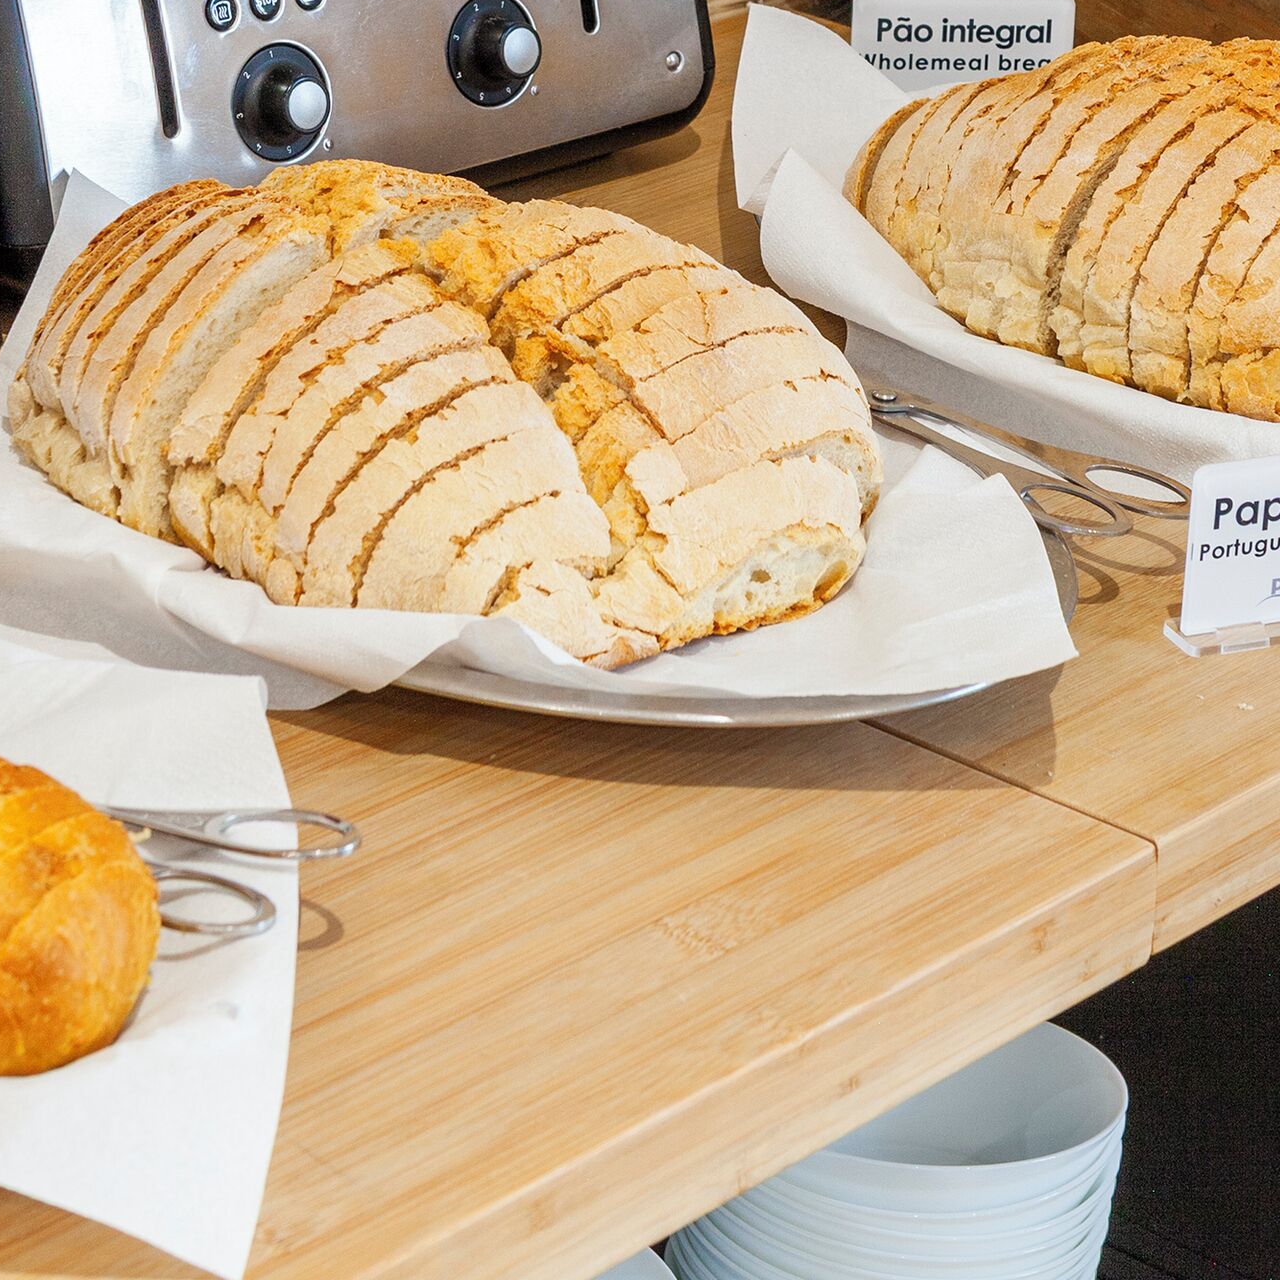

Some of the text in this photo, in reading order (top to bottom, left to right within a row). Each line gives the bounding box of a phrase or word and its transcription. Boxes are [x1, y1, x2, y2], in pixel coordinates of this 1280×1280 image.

[876, 16, 1053, 50] Pão integral
[473, 3, 480, 12] 2
[479, 91, 485, 101] 5
[998, 54, 1052, 71] bre
[242, 71, 251, 80] 2
[235, 112, 244, 120] 3
[286, 145, 292, 154] 5
